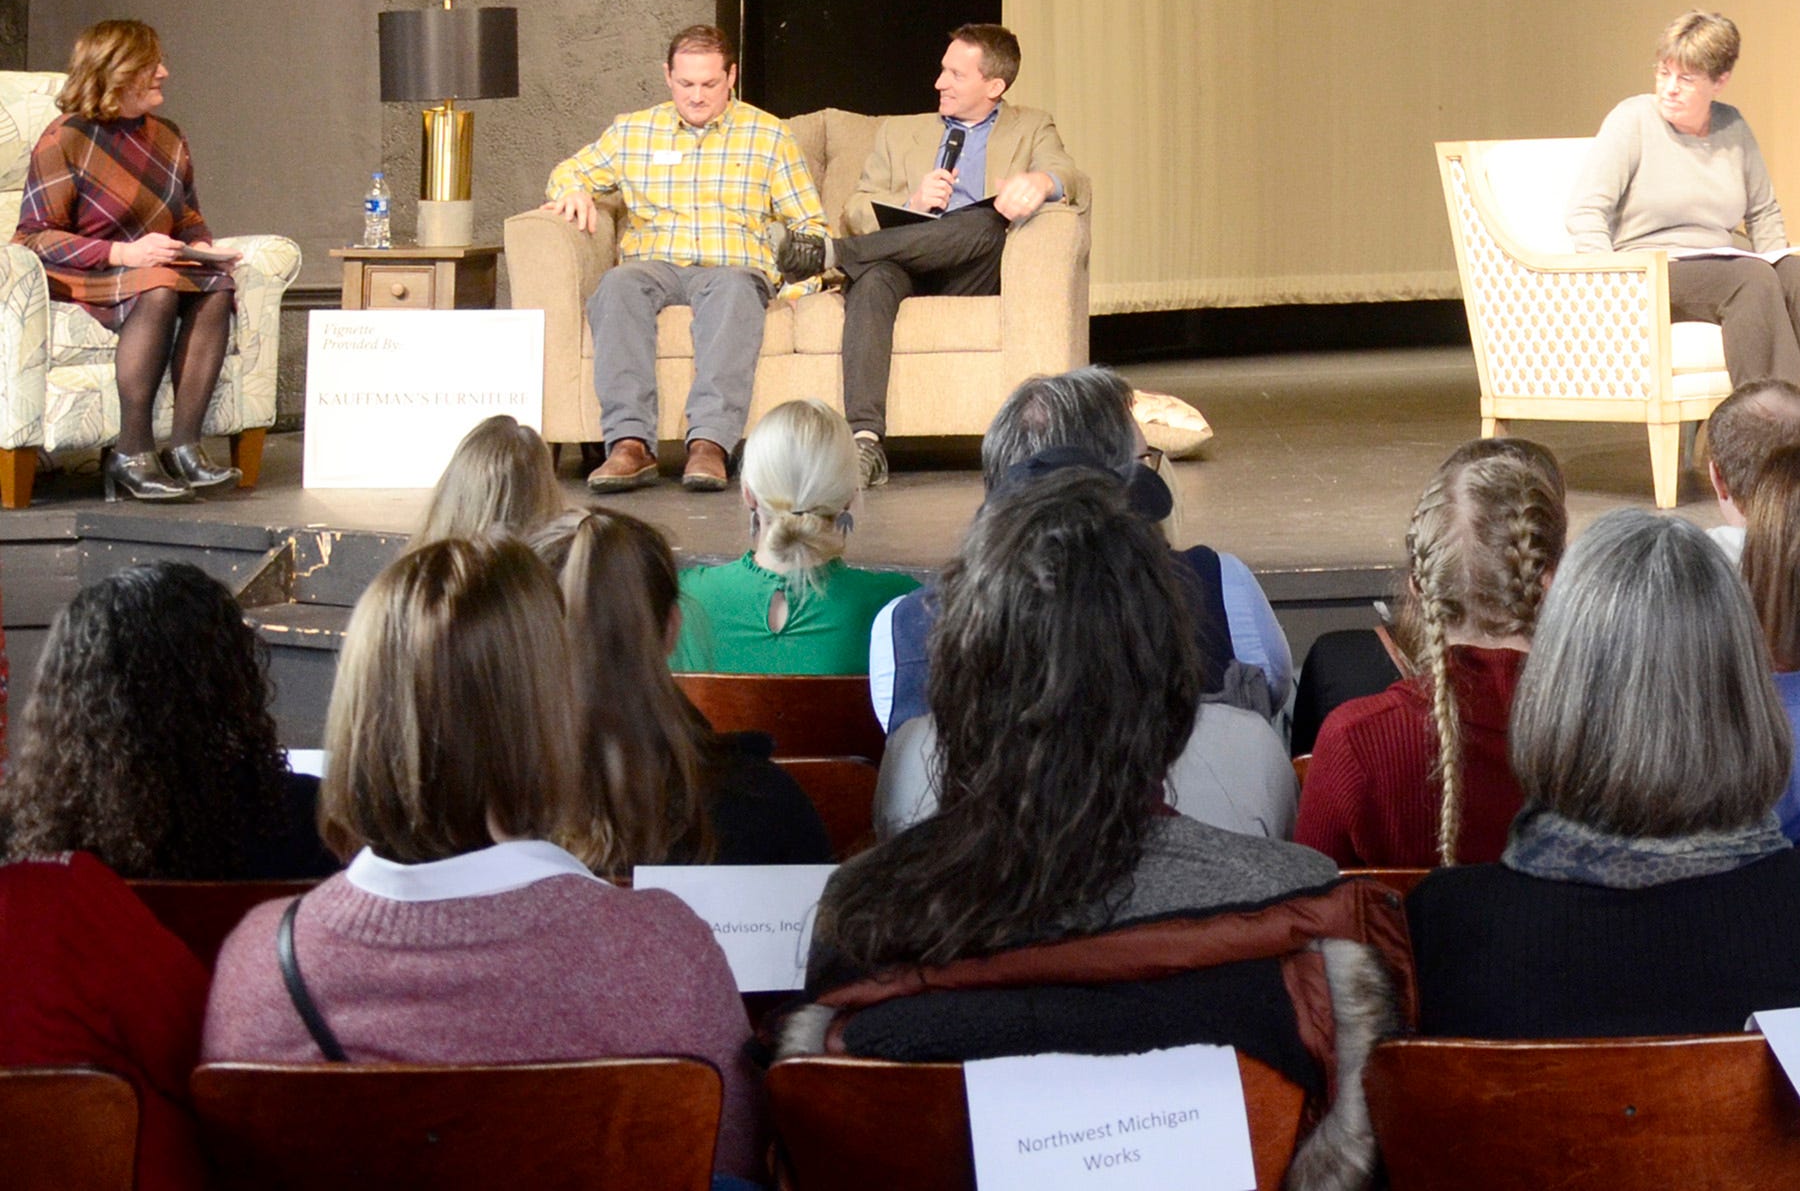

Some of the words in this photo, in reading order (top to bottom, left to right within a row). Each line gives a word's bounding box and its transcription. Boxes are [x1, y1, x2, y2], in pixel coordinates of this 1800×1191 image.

[322, 339, 377, 350] Provided
[1017, 1123, 1113, 1154] Northwest
[1117, 1107, 1201, 1135] Michigan
[1083, 1147, 1142, 1172] Works
